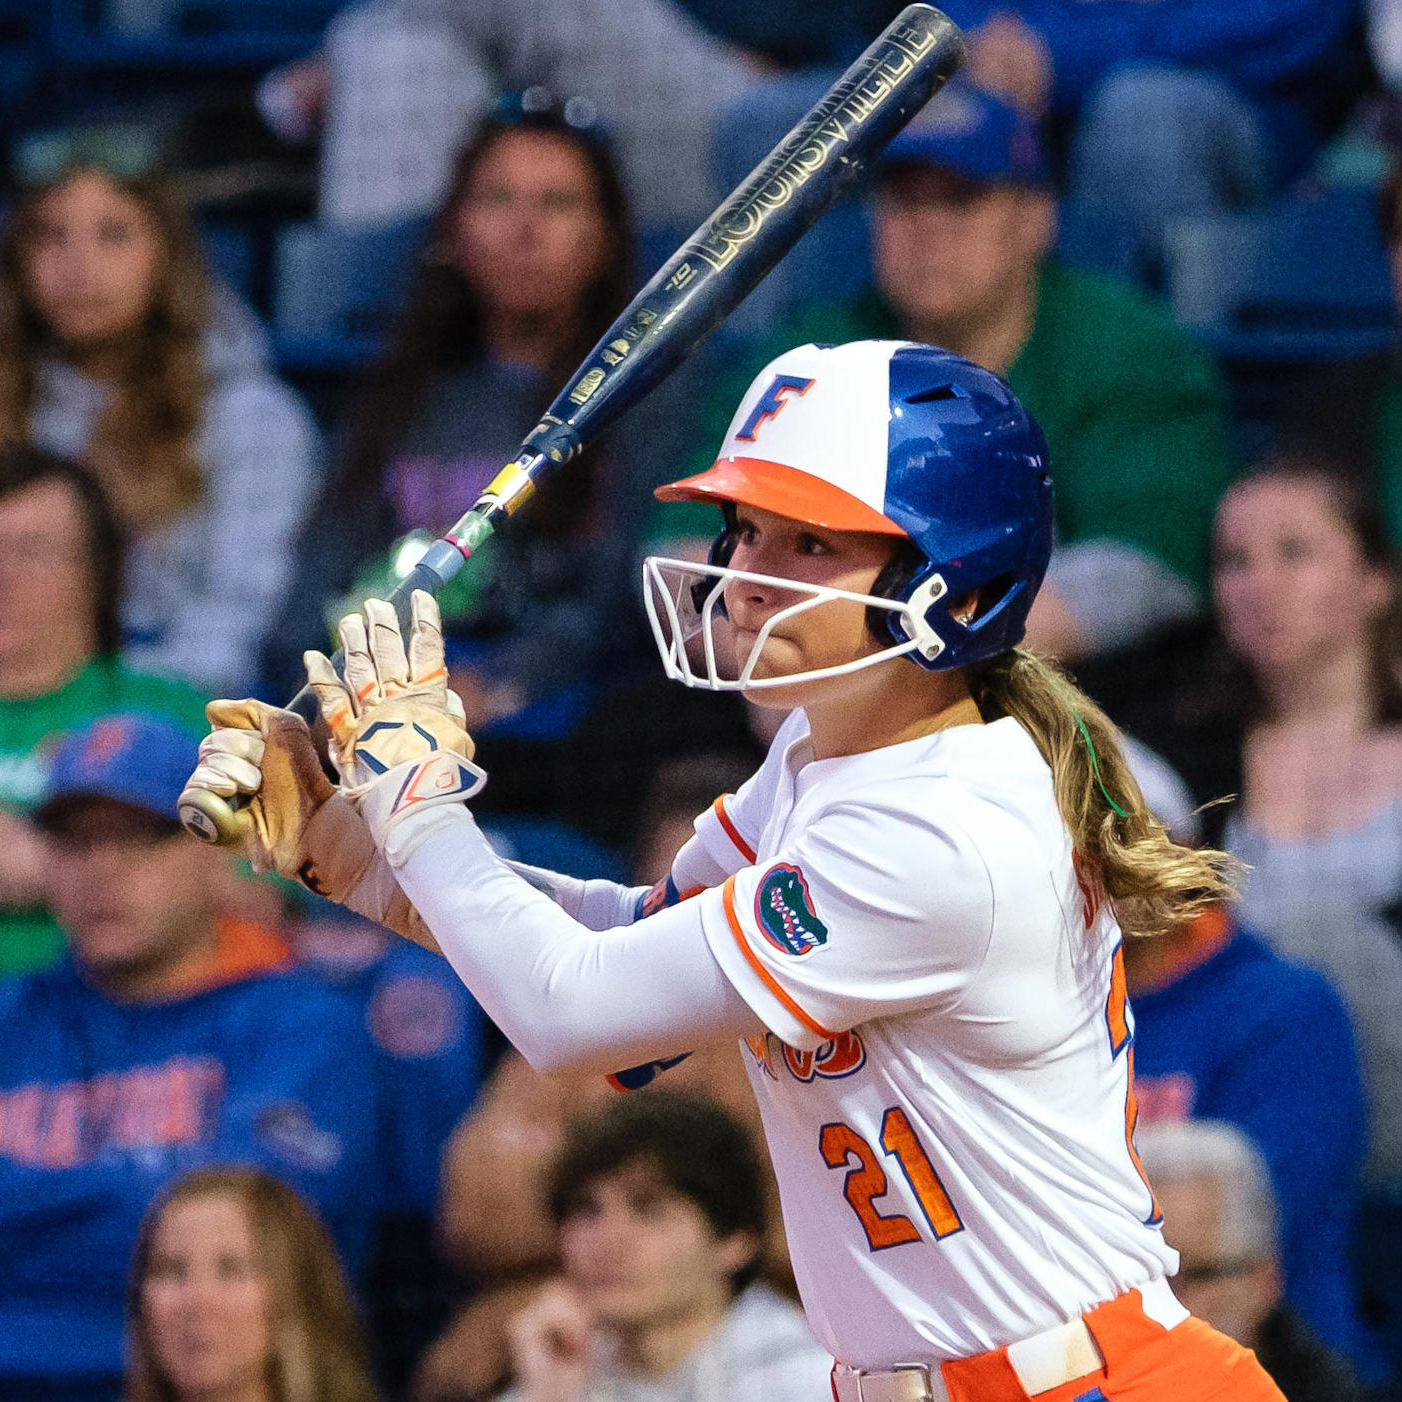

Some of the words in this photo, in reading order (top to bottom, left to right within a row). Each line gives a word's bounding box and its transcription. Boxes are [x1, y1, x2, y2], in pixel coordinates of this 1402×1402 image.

[695, 26, 937, 272] LOUISVILLE
[734, 374, 816, 443] F
[819, 1107, 965, 1253] 21
